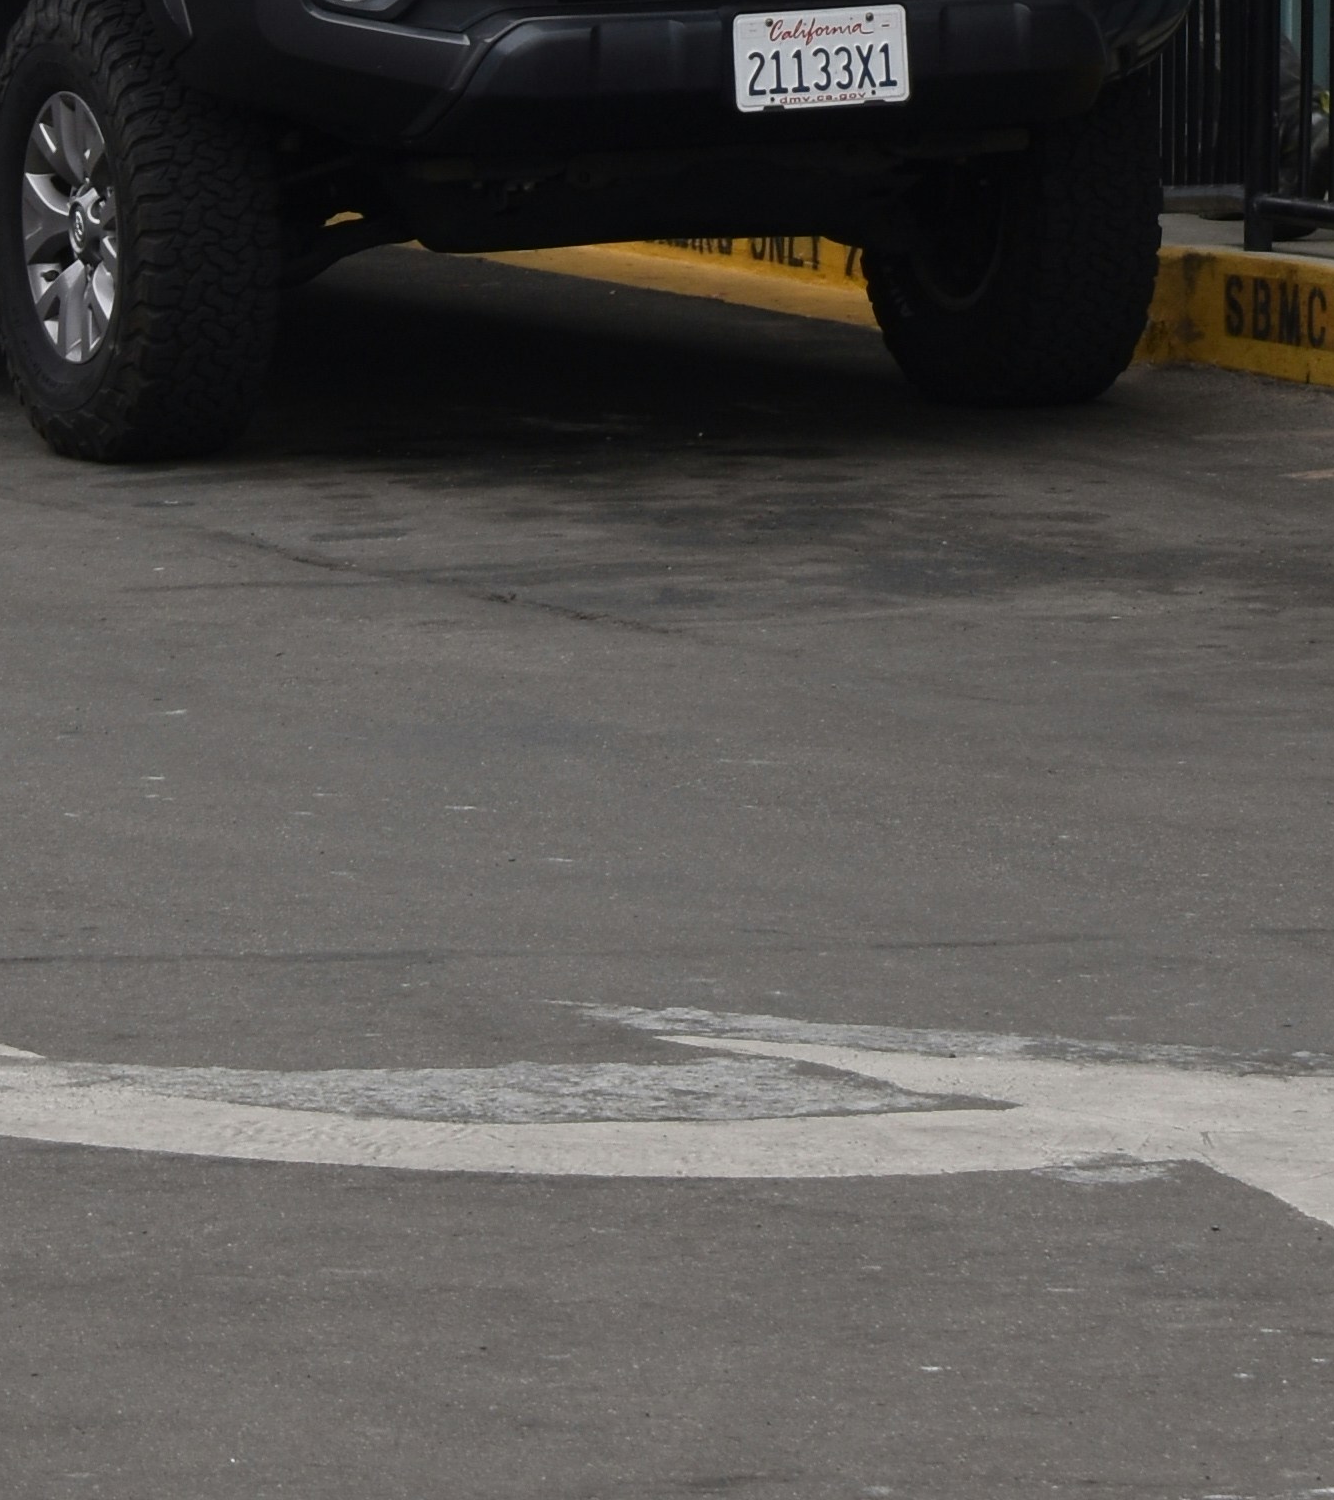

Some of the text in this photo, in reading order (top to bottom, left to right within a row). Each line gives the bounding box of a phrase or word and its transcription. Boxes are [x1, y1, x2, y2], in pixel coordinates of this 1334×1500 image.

[769, 17, 874, 46] California
[747, 42, 898, 97] 21133X1
[779, 91, 867, 105] dmv.ca.gov
[1223, 273, 1328, 349] SBMC
